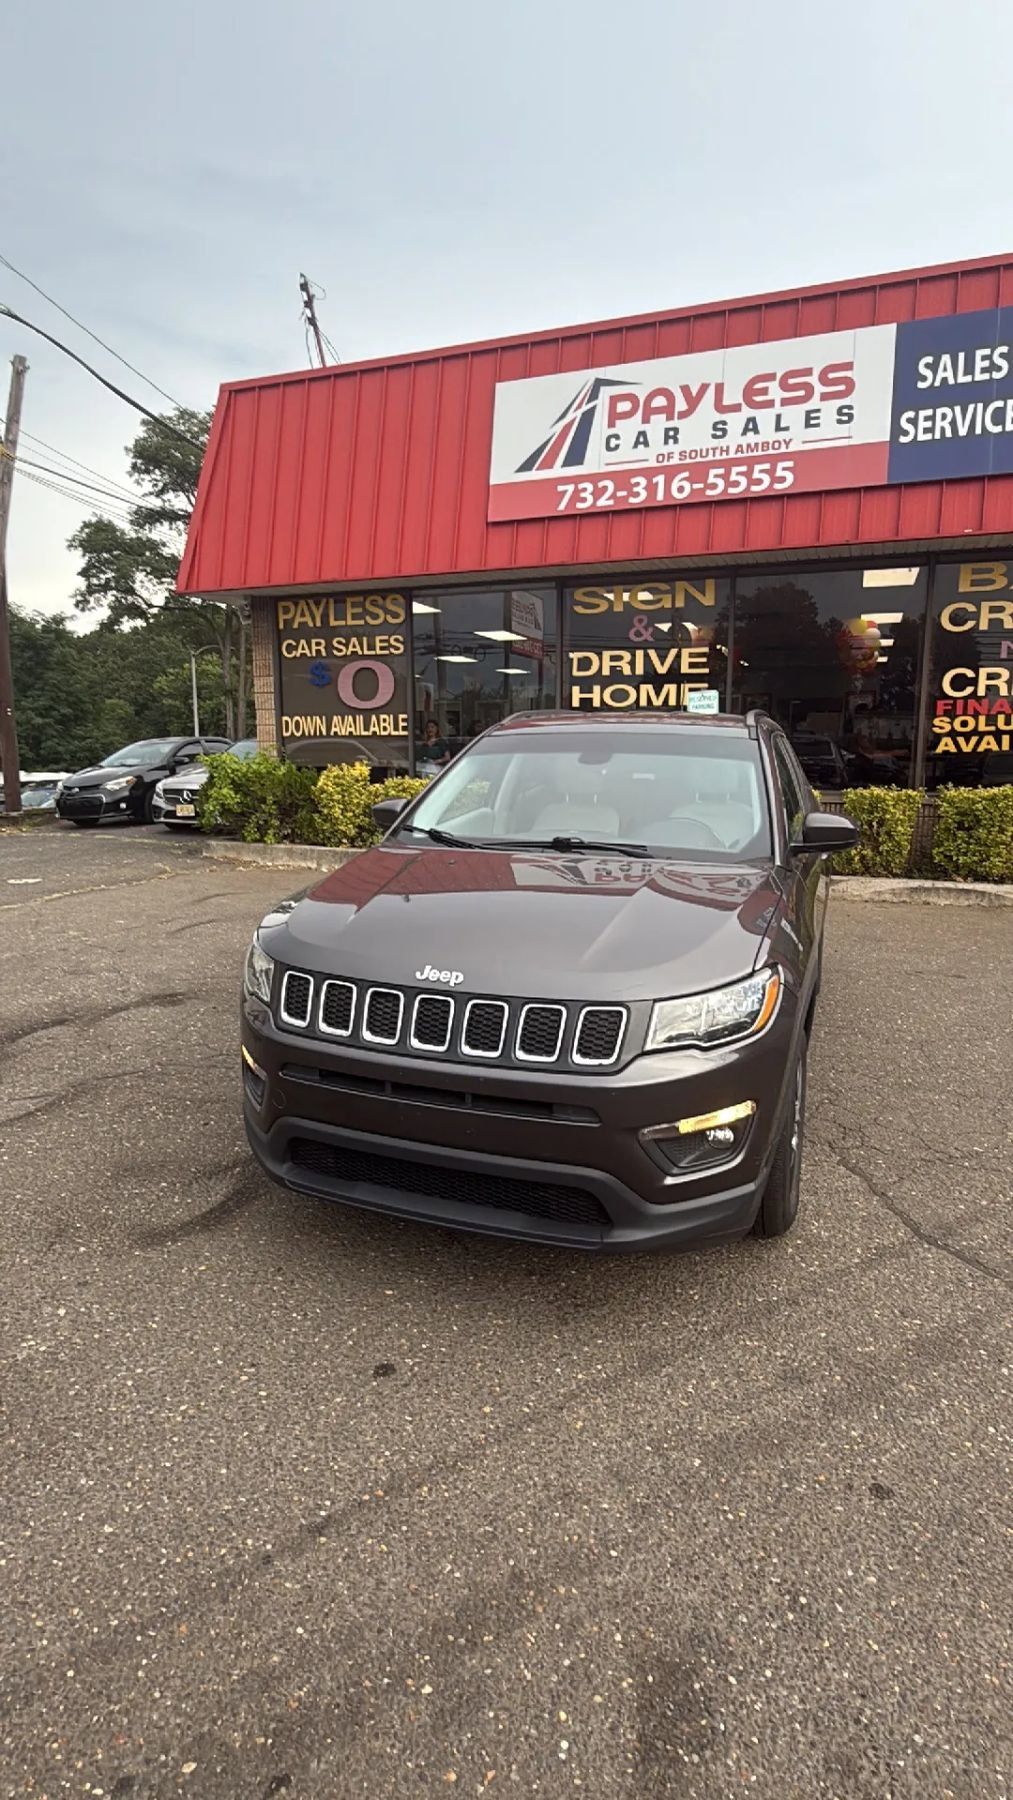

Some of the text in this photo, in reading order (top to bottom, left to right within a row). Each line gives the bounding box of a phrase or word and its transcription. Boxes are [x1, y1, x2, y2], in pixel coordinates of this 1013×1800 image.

[917, 346, 1009, 388] SALES
[607, 362, 856, 428] PAYLESS
[605, 405, 854, 452] CAR SALES
[656, 438, 793, 464] OF SOUTH AMBOY
[556, 460, 794, 511] 732-316-5555
[958, 561, 1013, 592] B
[277, 593, 406, 630] PAYLESS
[573, 579, 716, 614] SIGN
[628, 615, 655, 642] &
[282, 635, 404, 658] CAR SALES
[572, 648, 709, 676] DRIVE
[942, 667, 1013, 697] CR
[282, 714, 408, 737] DOWN AVAILABLE
[935, 735, 1010, 753] AVAI
[415, 965, 464, 987] Jeep
